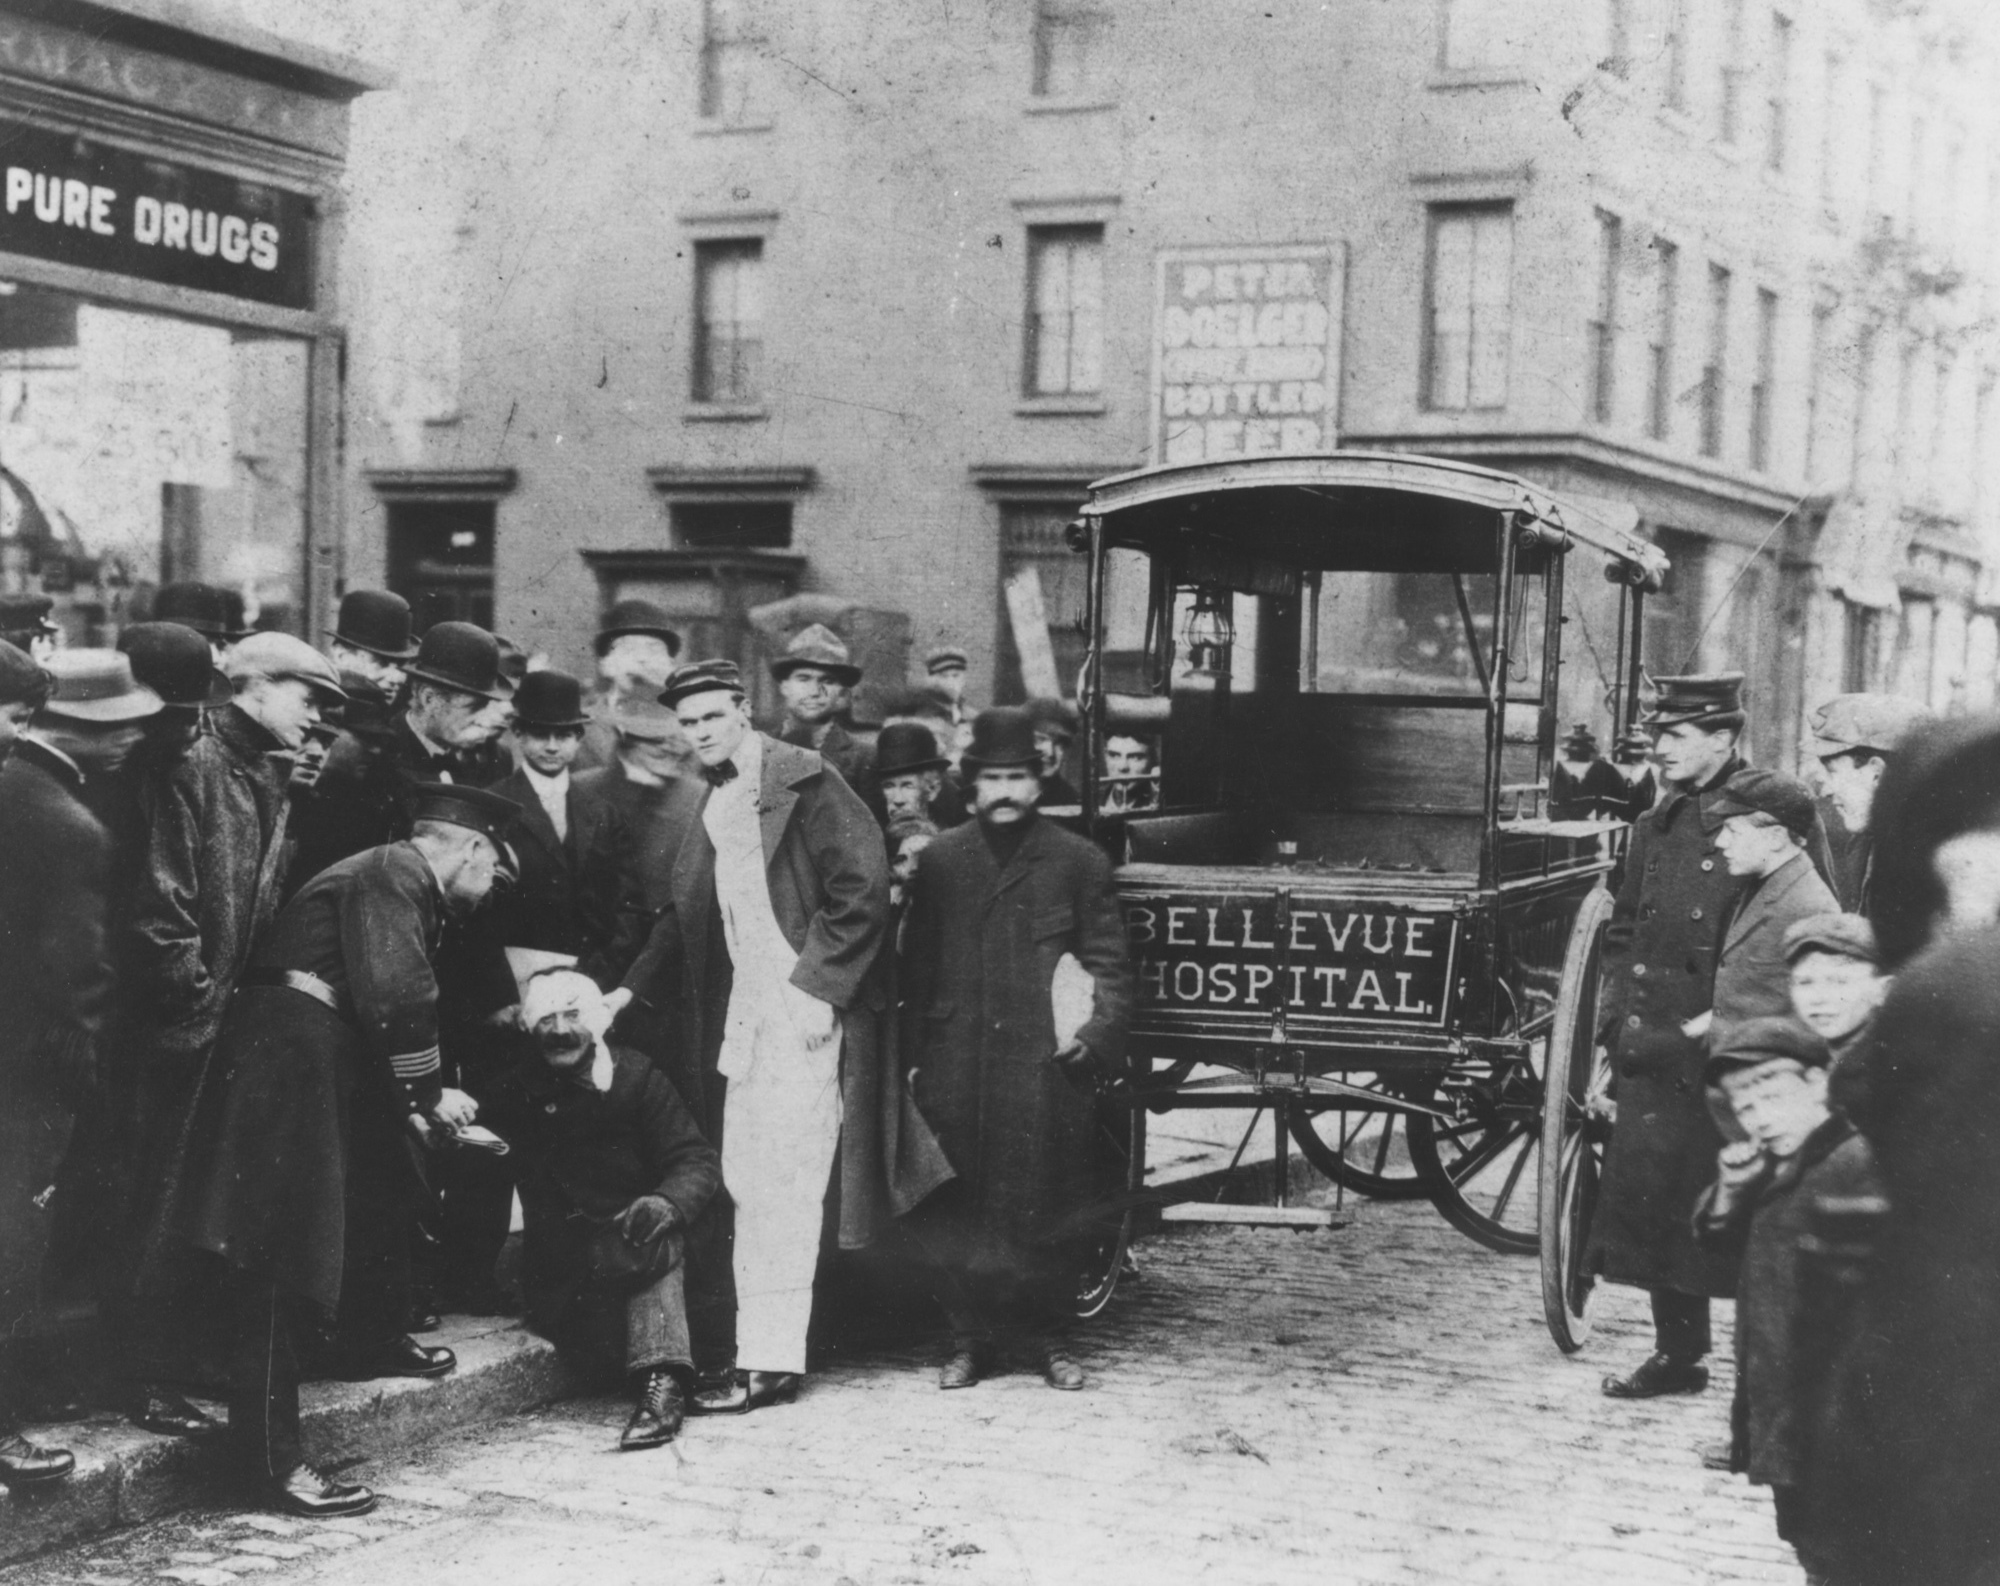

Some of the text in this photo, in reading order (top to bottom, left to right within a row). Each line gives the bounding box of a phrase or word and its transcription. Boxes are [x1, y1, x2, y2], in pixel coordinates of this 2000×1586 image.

[6, 166, 279, 271] PURE DRUGS
[1164, 381, 1325, 416] BOTTLED
[1128, 906, 1435, 957] BELLEVUE
